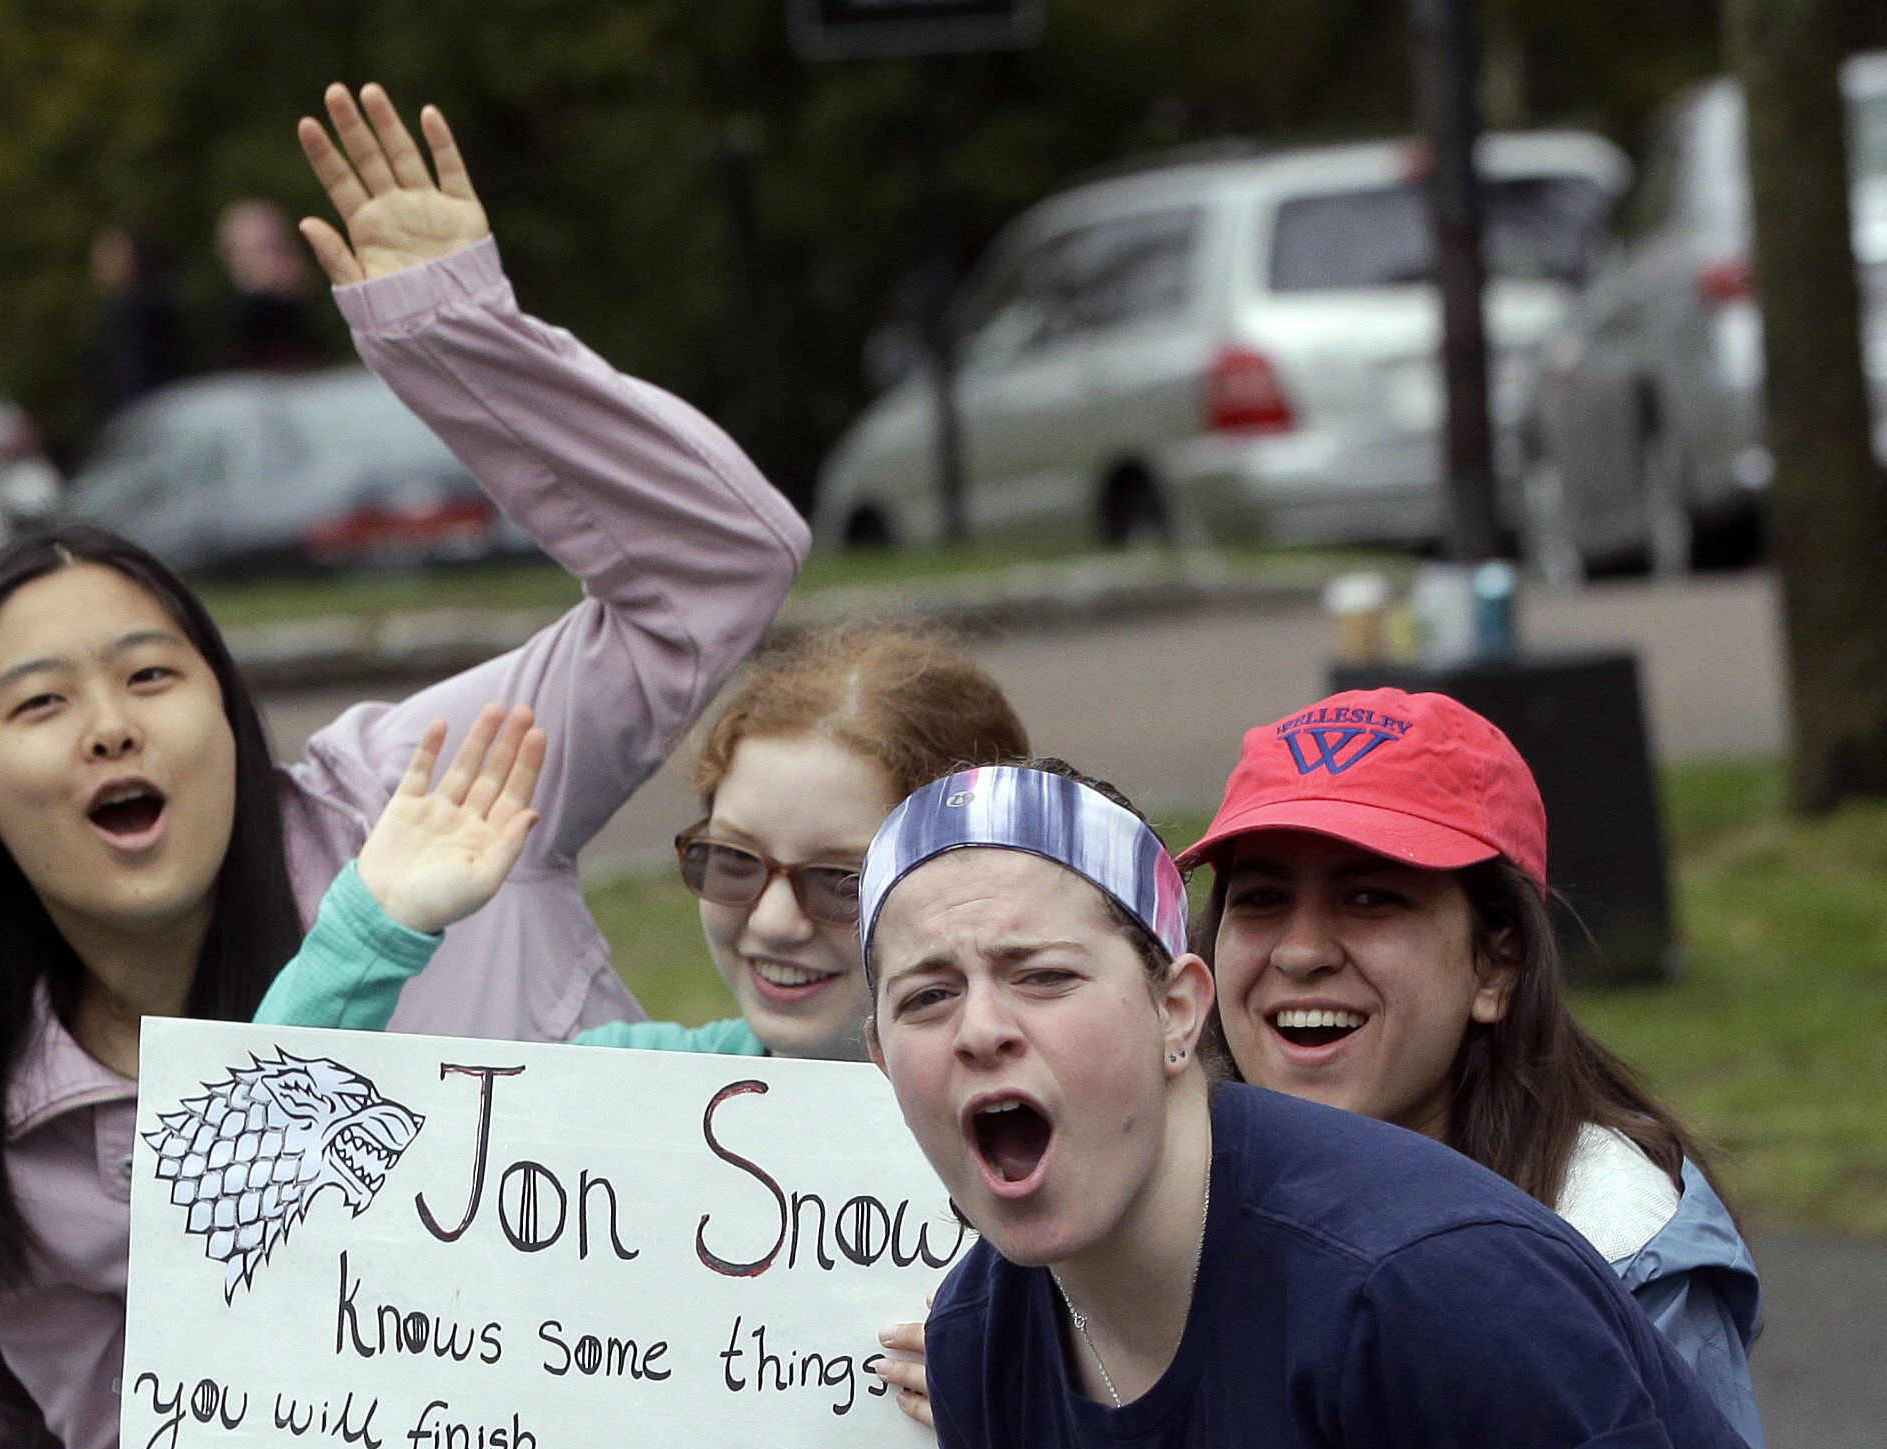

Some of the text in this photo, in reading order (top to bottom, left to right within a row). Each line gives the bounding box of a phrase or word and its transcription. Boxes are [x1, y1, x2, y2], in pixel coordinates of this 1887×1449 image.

[1276, 707, 1414, 736] WELLESLEY
[1277, 727, 1400, 776] W
[415, 1063, 964, 1278] Jon Snow
[719, 1315, 890, 1416] things
